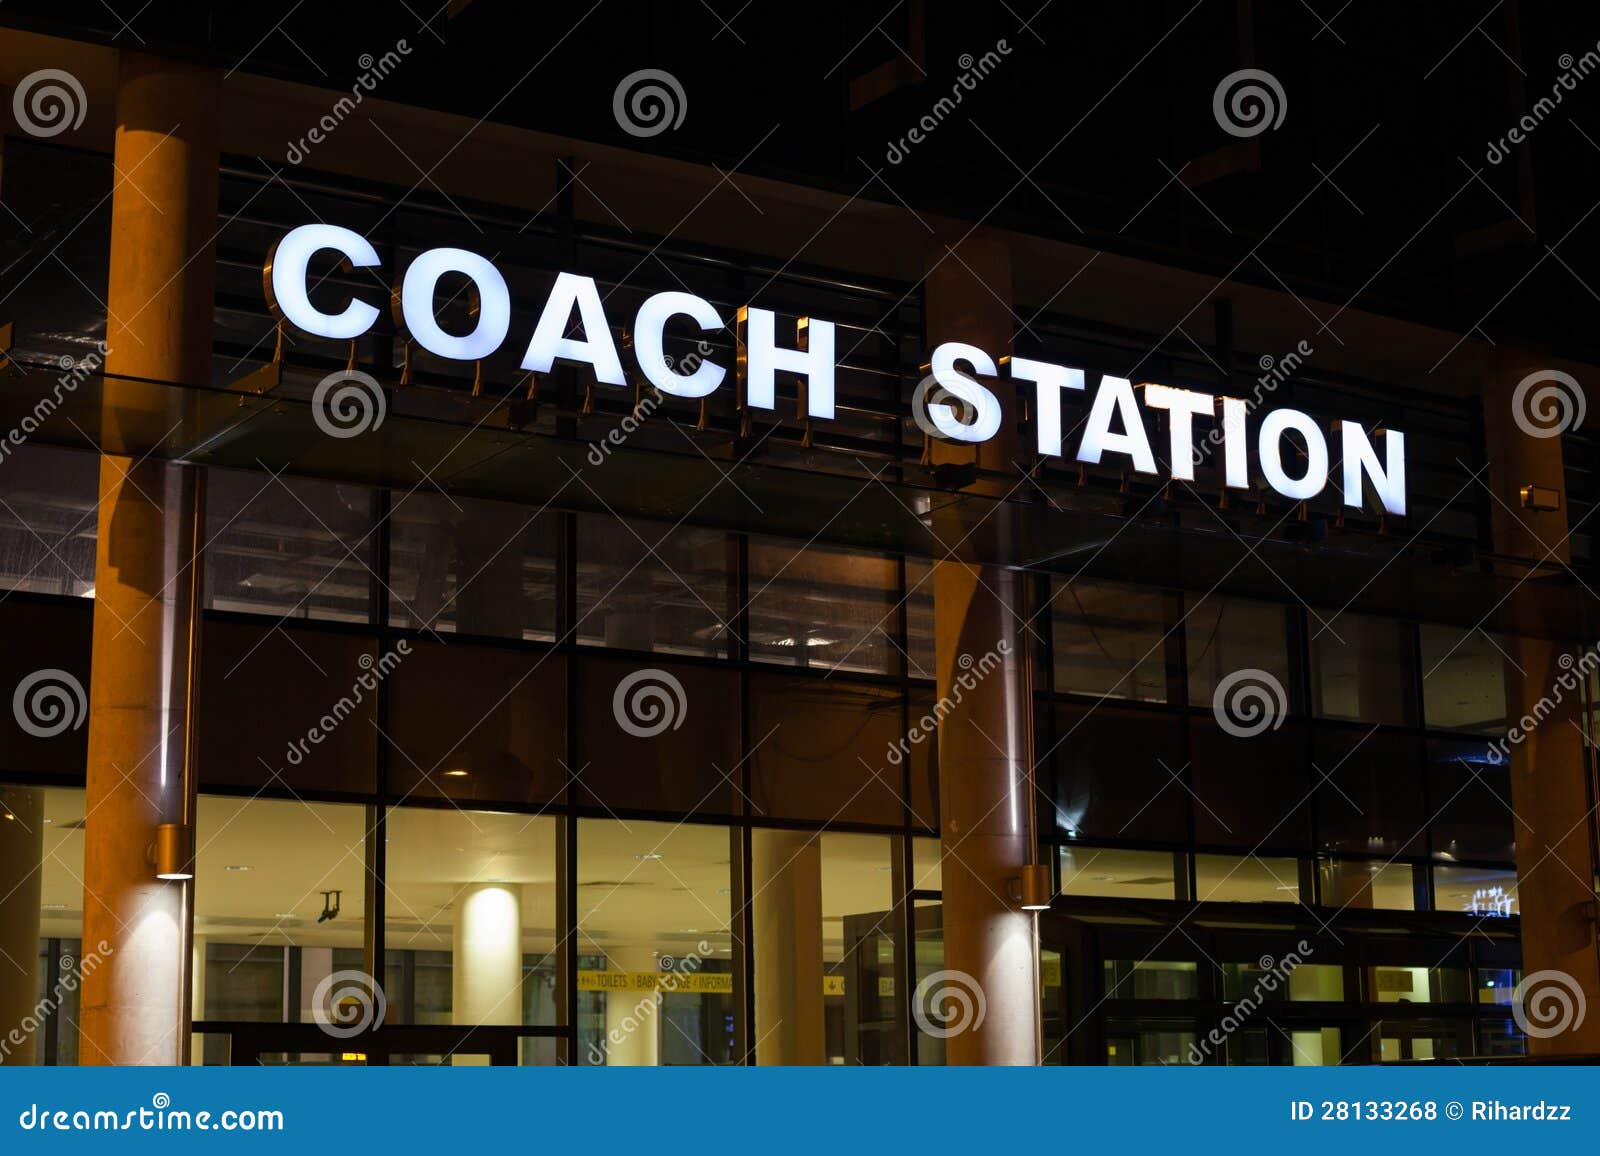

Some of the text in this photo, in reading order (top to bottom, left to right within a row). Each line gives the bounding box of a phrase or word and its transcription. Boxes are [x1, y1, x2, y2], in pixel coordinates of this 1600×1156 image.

[272, 223, 1406, 515] COACH STATION
[597, 974, 627, 988] TOILETS
